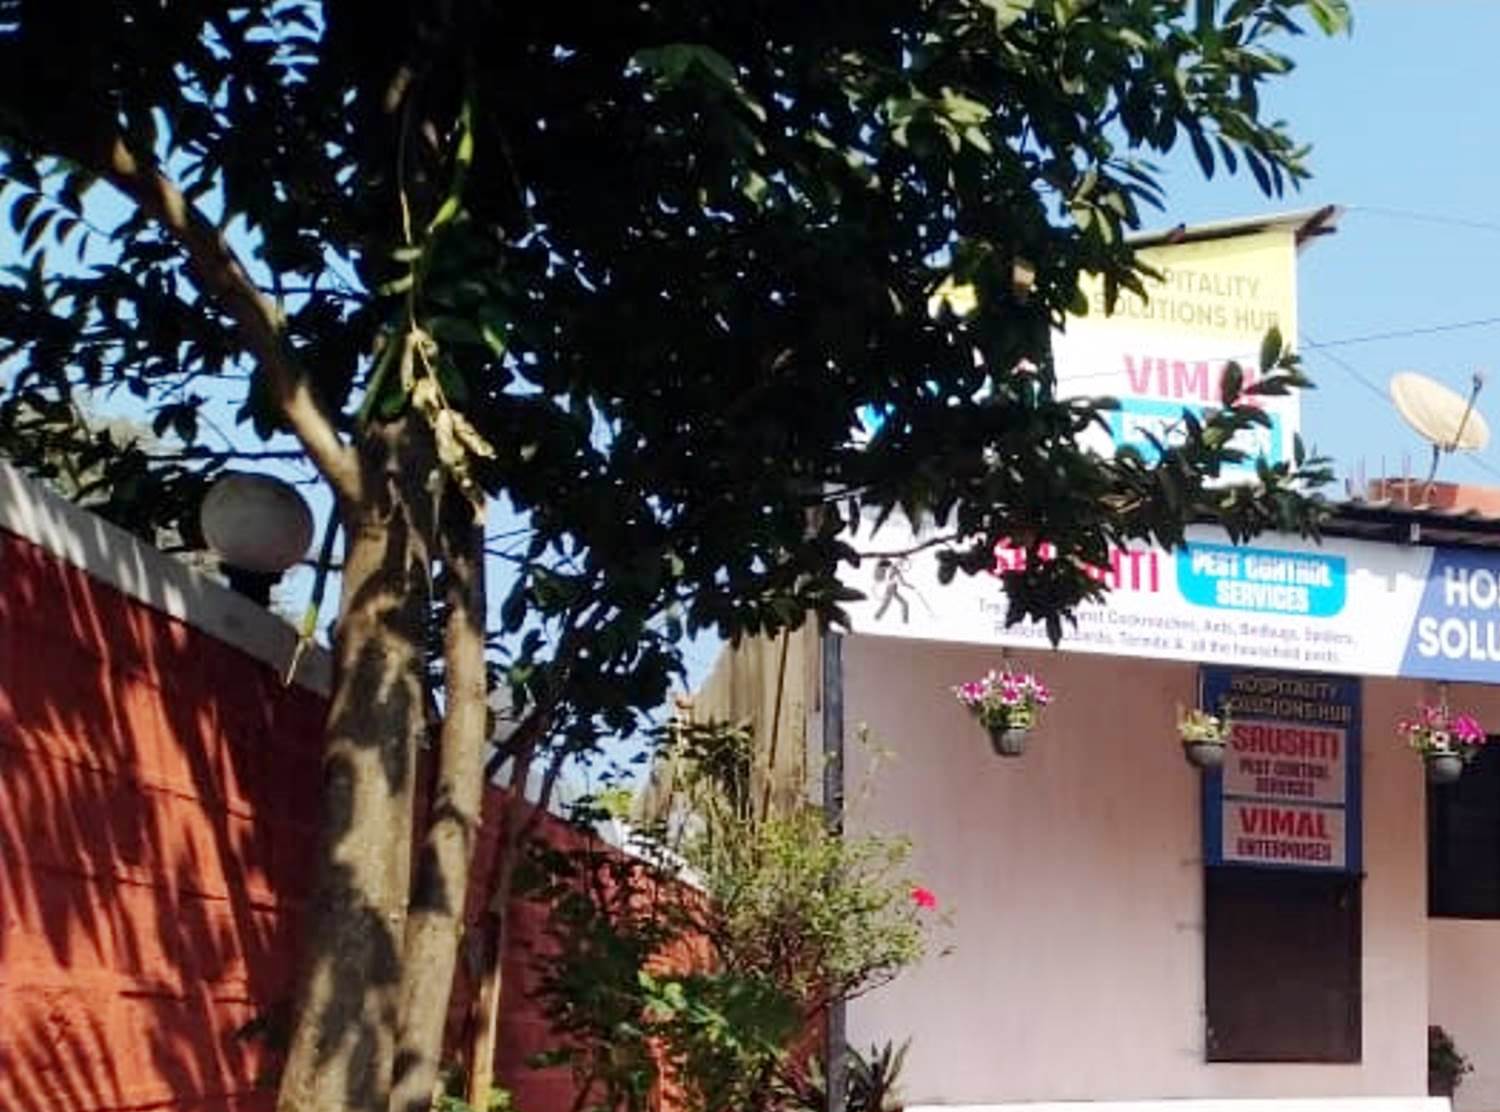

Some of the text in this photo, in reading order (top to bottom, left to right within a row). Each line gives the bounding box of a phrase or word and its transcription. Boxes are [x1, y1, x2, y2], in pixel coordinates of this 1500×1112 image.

[1122, 353, 1263, 409] VIML
[1216, 579, 1310, 615] SERVICES
[1239, 806, 1331, 839] VIMAL
